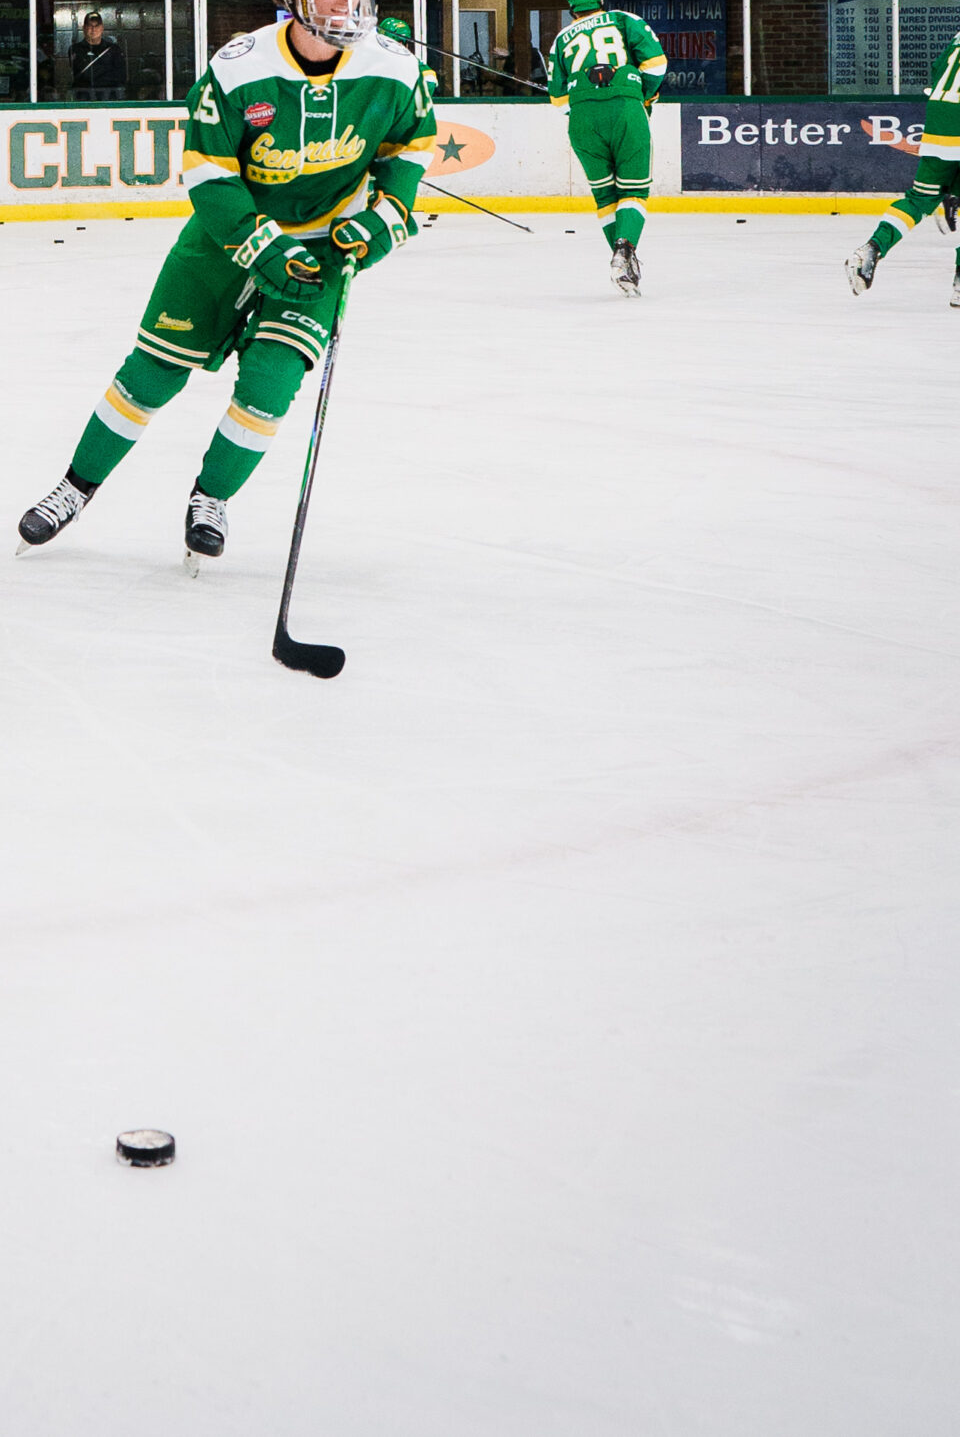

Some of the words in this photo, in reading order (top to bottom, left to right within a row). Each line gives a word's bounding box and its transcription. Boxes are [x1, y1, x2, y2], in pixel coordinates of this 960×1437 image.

[641, 1, 664, 20] Tier
[928, 15, 960, 23] DIVISIO
[929, 6, 960, 14] DIVISIO
[562, 13, 615, 44] O'CONNELL
[929, 24, 960, 32] DIVISIO
[562, 25, 628, 74] 78
[697, 115, 851, 146] Better
[868, 115, 926, 146] Ba
[8, 117, 190, 190] CLU
[281, 310, 329, 339] CCM
